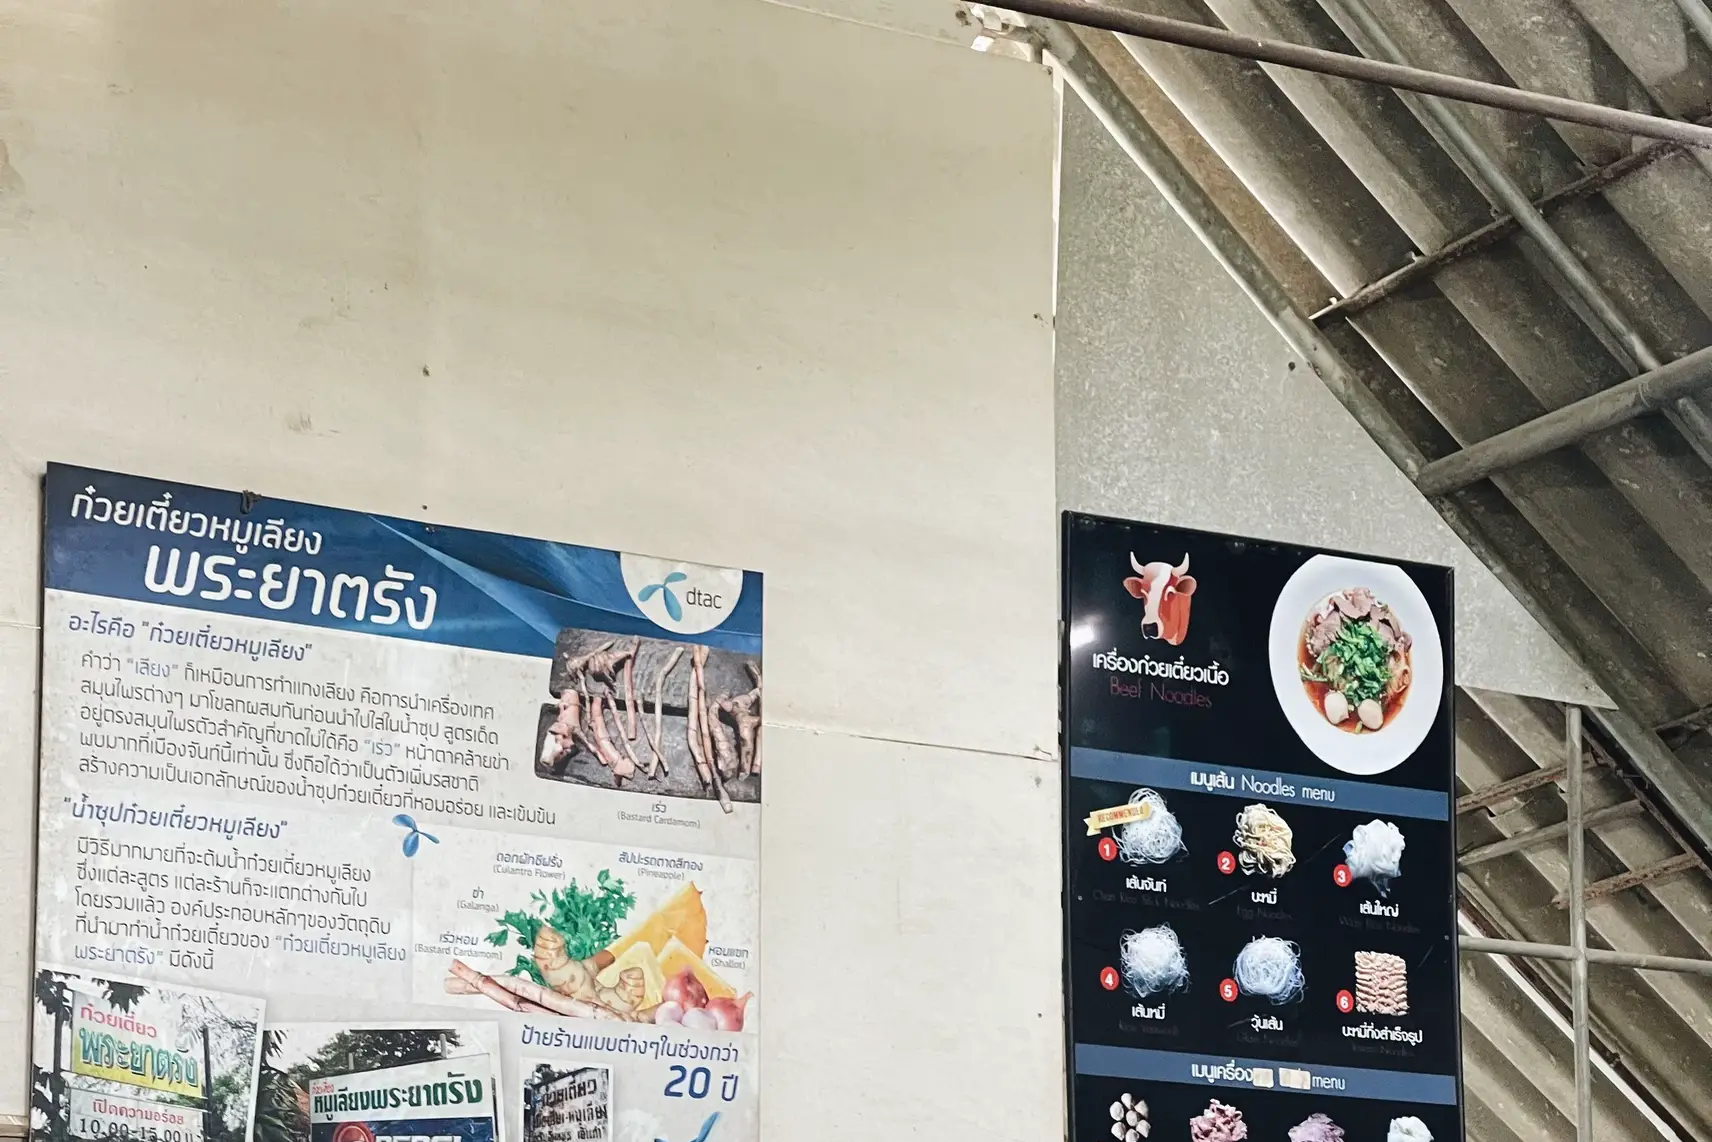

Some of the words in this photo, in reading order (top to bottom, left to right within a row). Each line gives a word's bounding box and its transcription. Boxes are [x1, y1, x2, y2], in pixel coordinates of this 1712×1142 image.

[70, 485, 323, 554] ก๋วยเตี๋ยวหมูเลียง
[143, 544, 438, 631] พระยาตรัง
[686, 587, 723, 610] dtac
[68, 610, 136, 639] อะไรคือ
[1092, 646, 1230, 687] เครื่องก๋วยเตี๋ยวเนื้อ
[81, 650, 121, 672] คำว่า
[184, 663, 356, 702] ก็เหมือนการทำแกงเลียง
[360, 686, 495, 720] คือการนำเครื่องเทศ
[1110, 675, 1143, 699] Beef
[1150, 682, 1213, 709] Noodles
[80, 677, 184, 709] สมุนไพรต่างๆ
[444, 724, 499, 745] สูตรเด็ด
[405, 744, 510, 772] หน้าตาคล้ายข่า
[1190, 770, 1236, 792] เมนูเส้น
[1241, 774, 1296, 798] Noodles
[1301, 786, 1336, 802] menu
[488, 801, 556, 825] และเข้มข้น
[617, 811, 652, 823] (Bastard
[1103, 843, 1111, 857] 1
[637, 867, 685, 881] (Pineapple)
[1221, 857, 1230, 871] 2
[1337, 870, 1346, 884] 3
[76, 858, 169, 892] ซึ่งแต่ละสูตร
[174, 872, 367, 907] แต่ละร้านก็จะแตกต่างกันไป
[74, 885, 166, 914] โดยรวมแล้ว
[456, 899, 499, 913] (Galanga)
[1359, 899, 1400, 918] เส้นใหญ่
[169, 947, 214, 970] มีดังนี้
[1104, 972, 1113, 987] 4
[1223, 984, 1233, 998] 5
[1131, 1002, 1166, 1020] เส้นหมี่
[1340, 996, 1349, 1009] 6
[1250, 1013, 1284, 1032] วุ้นเส้น
[1341, 1021, 1424, 1047] บะหมี่กึ่งสำเร็จรูป
[521, 1024, 739, 1063] ป้ายร้านแบบต่างๆในช่วงกว่า
[78, 1027, 200, 1087] พระยาตรัง
[664, 1064, 712, 1100] 20
[720, 1072, 739, 1102] ปี
[1191, 1059, 1253, 1084] เมนูเครื่อง
[1312, 1074, 1346, 1090] menu
[314, 1071, 484, 1121] หมูเลียงพระยาตรัง
[92, 1099, 185, 1125] เปิดความอร่อย
